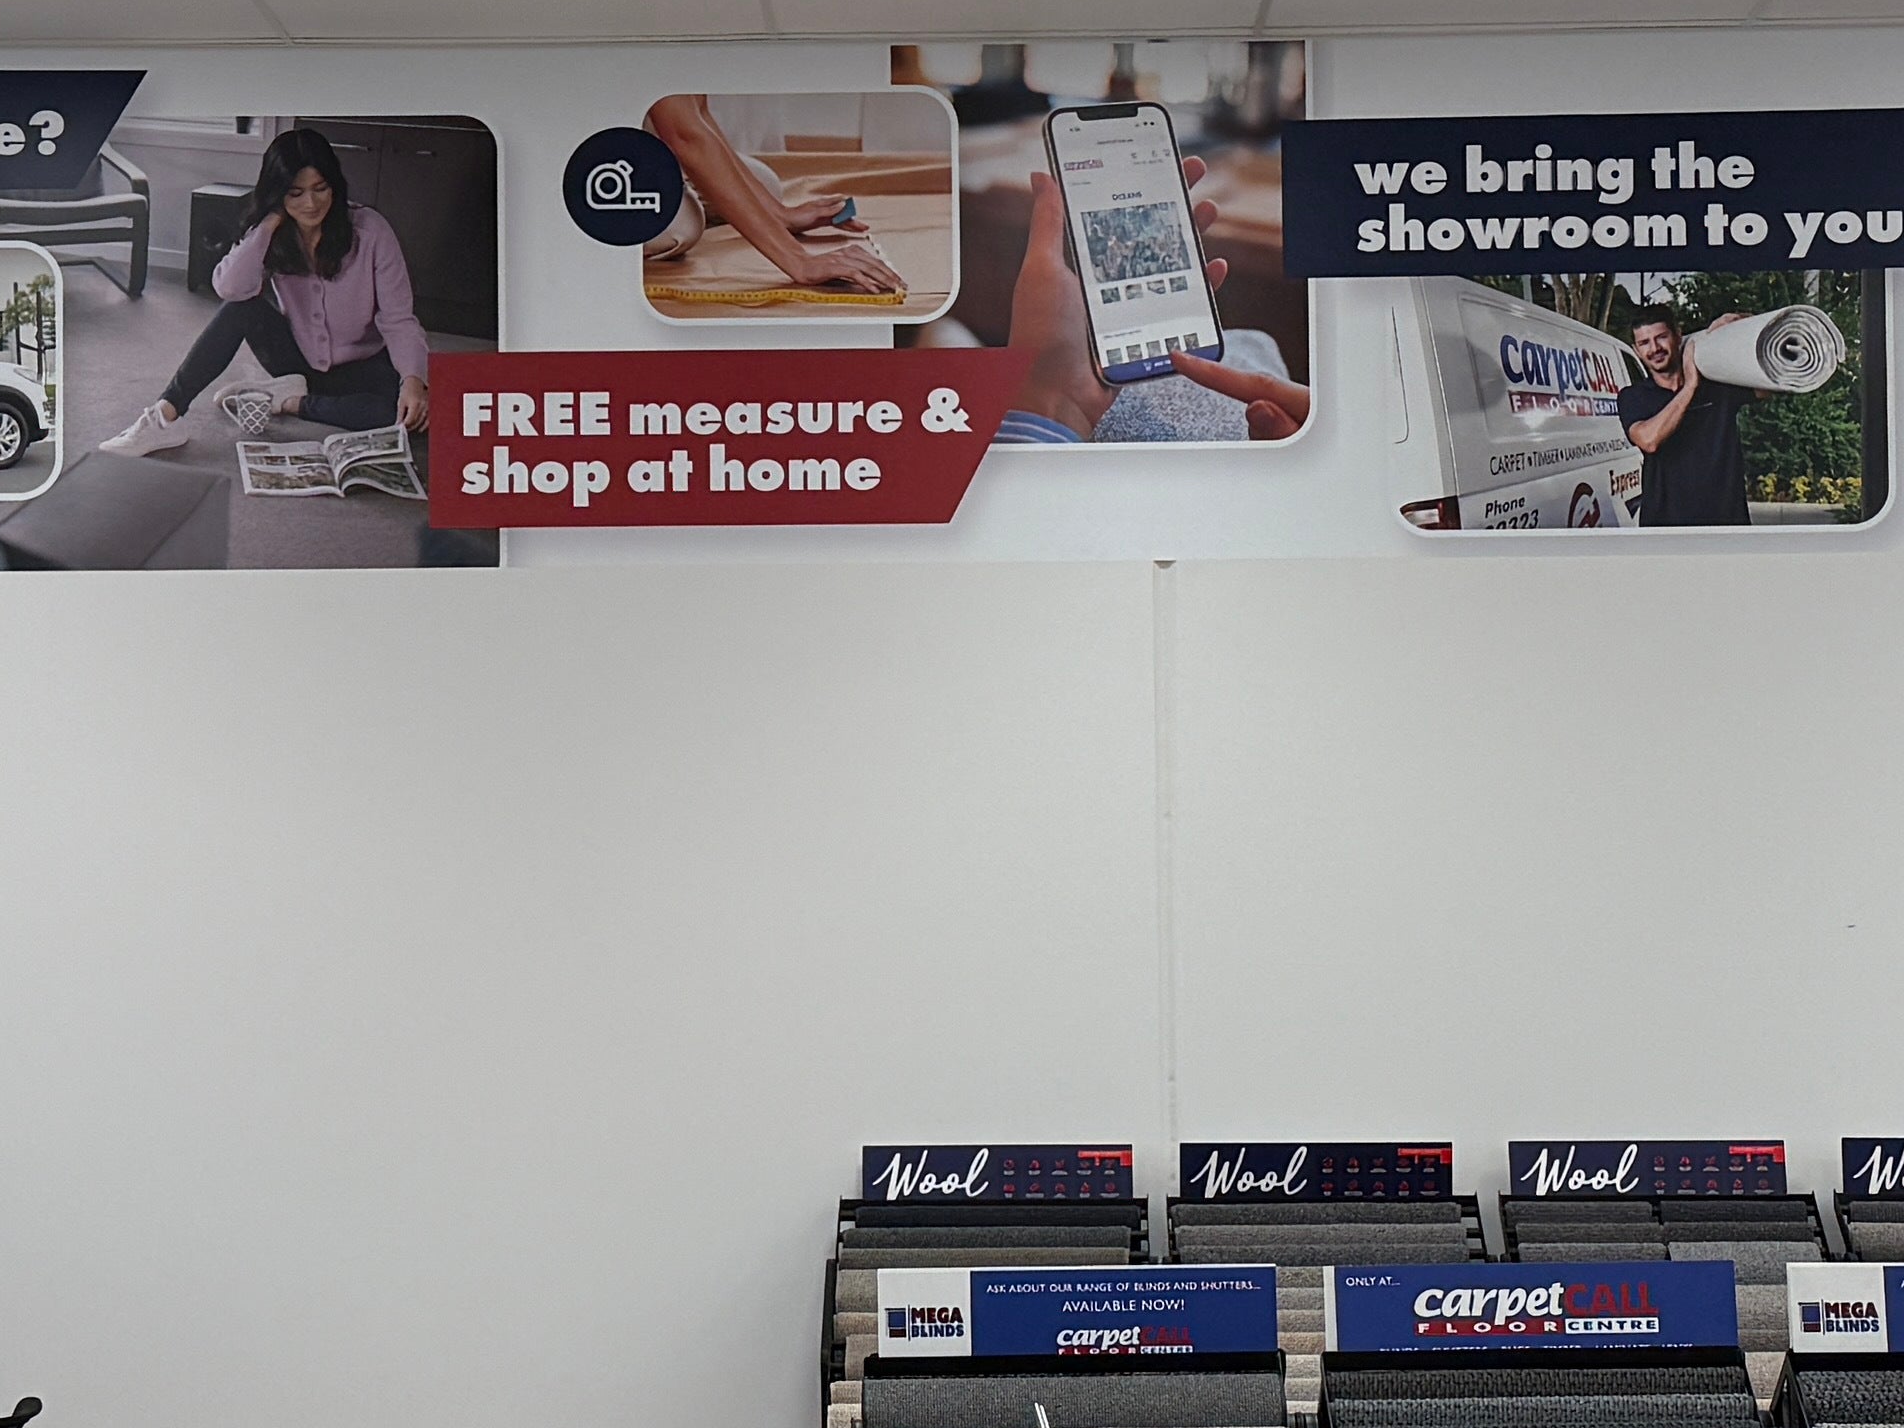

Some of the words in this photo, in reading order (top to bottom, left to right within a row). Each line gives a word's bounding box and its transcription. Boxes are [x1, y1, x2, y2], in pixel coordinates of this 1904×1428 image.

[1355, 158, 1448, 194] we
[1465, 143, 1634, 204] bring
[1652, 140, 1754, 189] the
[1357, 203, 1688, 252] showroom
[1704, 203, 1768, 247] to
[1784, 208, 1904, 258] you
[462, 391, 612, 436] FREE
[628, 396, 902, 436] measure
[920, 389, 973, 434] &
[461, 449, 610, 508] shop
[627, 449, 693, 492] at
[710, 444, 882, 492] home
[1485, 497, 1525, 518] Phone
[872, 1148, 989, 1200] Wool
[1190, 1145, 1307, 1199] Wool
[1520, 1144, 1640, 1196] Wool
[1173, 1282, 1197, 1291] AND
[1346, 1276, 1377, 1285] ONLY
[911, 1305, 964, 1325] MEGA
[1063, 1300, 1136, 1312] AVAILABLE
[1141, 1299, 1185, 1311] NOW!
[1825, 1302, 1878, 1318] MEGA
[911, 1324, 964, 1338] BLINDS
[1418, 1321, 1563, 1333] FLOOR
[1567, 1319, 1657, 1332] CENTRE
[1826, 1318, 1880, 1333] BLINDS
